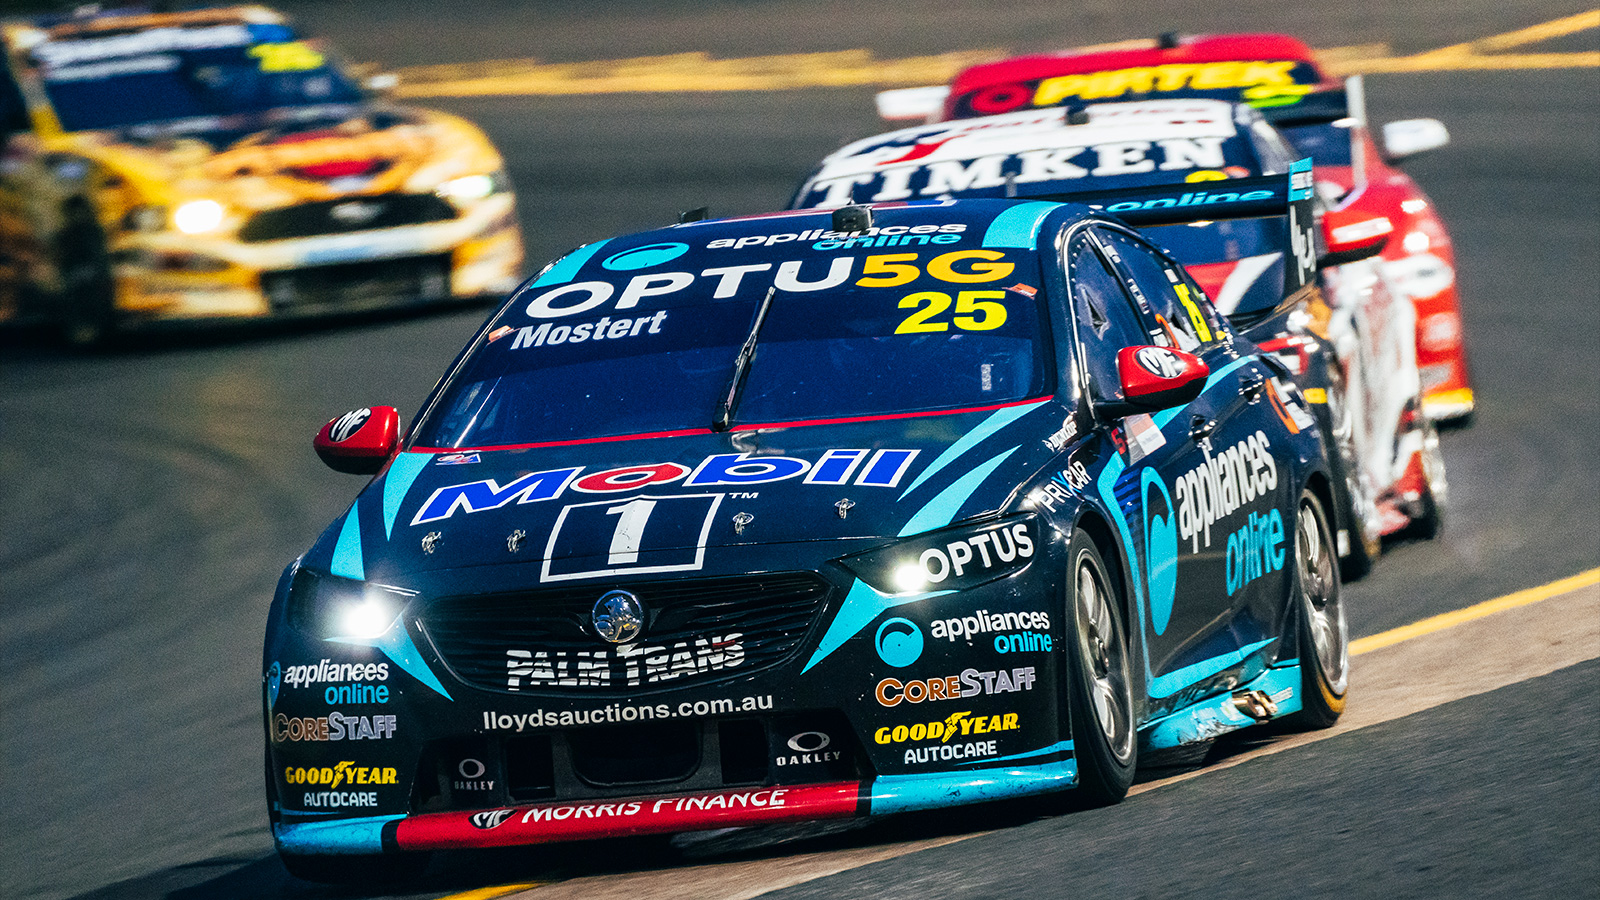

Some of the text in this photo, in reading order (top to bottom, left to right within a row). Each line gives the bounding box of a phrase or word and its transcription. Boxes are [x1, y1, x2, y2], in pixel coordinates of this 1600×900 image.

[812, 136, 1229, 207] TIMKEN
[1106, 189, 1275, 212] online
[706, 223, 968, 249] appliances
[812, 232, 962, 251] online
[894, 290, 1008, 335] 25
[510, 310, 668, 350] Mostert
[409, 448, 922, 527] Mobil
[1039, 460, 1093, 513] PRIXCAR
[1175, 430, 1278, 554] appliances
[605, 500, 658, 565] 1
[918, 523, 1035, 583] OPTUS
[1225, 508, 1286, 597] online
[930, 609, 1050, 642] appliances
[993, 631, 1053, 654] online
[283, 658, 390, 688] appliances
[506, 632, 745, 691] PALM TRANS
[324, 684, 390, 705] online
[482, 694, 774, 732] lloydsauctions.com.au
[776, 750, 841, 766] OAKLEY
[904, 740, 998, 764] AUTOCARE
[303, 791, 378, 807] AUTOCARE
[454, 780, 495, 791] OAKLEY
[521, 801, 643, 823] MORRIS
[652, 789, 790, 814] FINANCE
